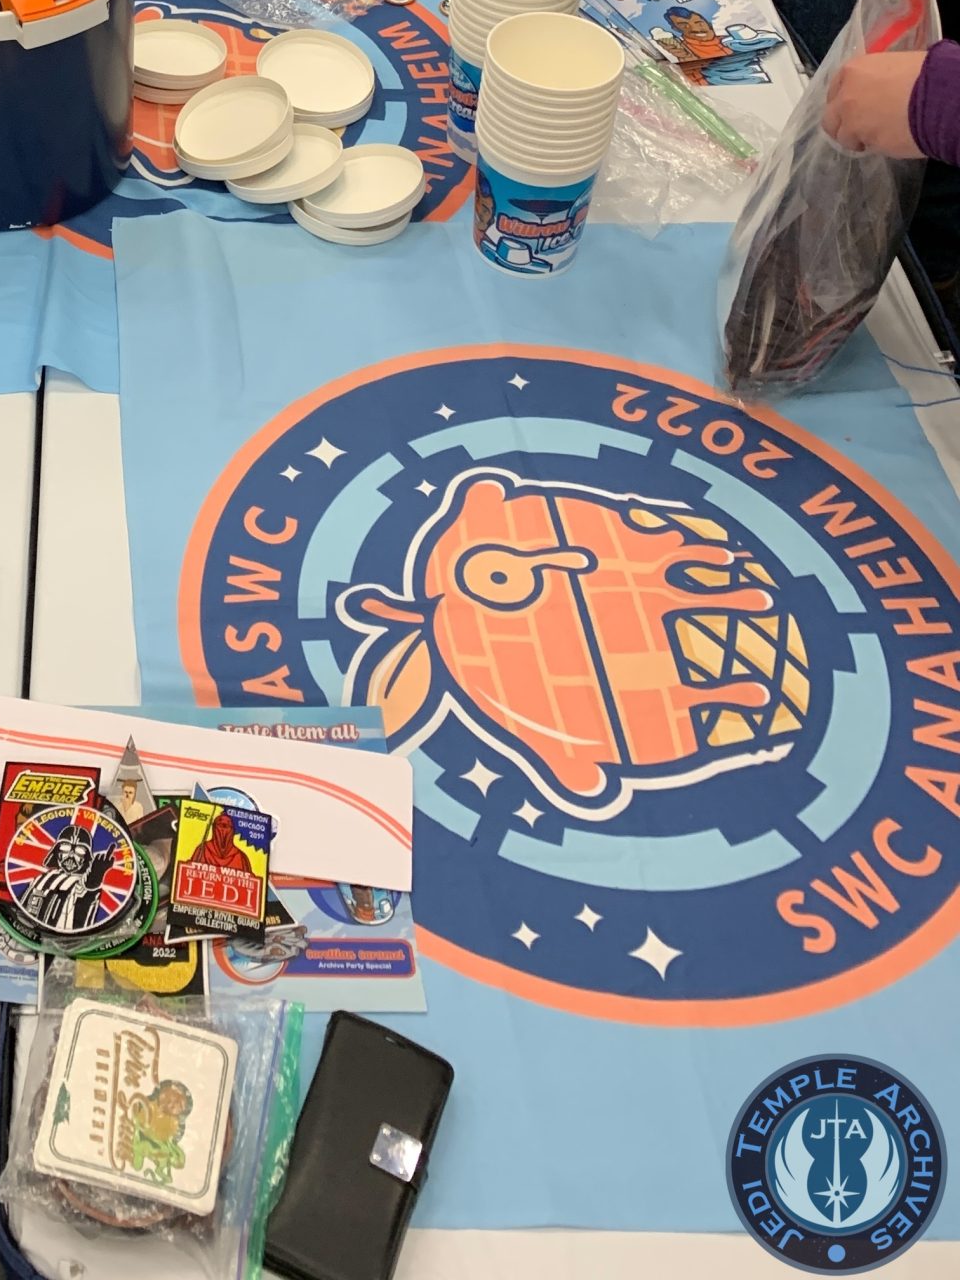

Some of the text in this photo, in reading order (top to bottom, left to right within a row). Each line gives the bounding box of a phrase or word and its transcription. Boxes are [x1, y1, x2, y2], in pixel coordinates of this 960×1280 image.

[542, 230, 568, 252] Ice
[611, 383, 796, 480] 2022
[225, 505, 306, 704] ASWC
[775, 484, 960, 955] SWC ANAHEIM
[276, 723, 327, 740] them
[330, 724, 359, 741] all
[14, 774, 85, 797] EMPIRE
[8, 790, 80, 805] STRIKES BACK
[226, 808, 269, 824] CELEBRATION
[238, 820, 266, 832] CHICAGO
[249, 831, 265, 840] 2019
[36, 808, 134, 876] LEGION VADER'S FINGER
[186, 870, 255, 889] RETURN OF THE
[190, 861, 252, 880] STAR WARS
[183, 878, 253, 908] JEDI
[172, 904, 261, 931] EMPEROR'S ROYAL GUARD
[195, 916, 238, 934] COLLECTORS
[152, 946, 177, 959] 2022
[318, 961, 393, 970] Archive Party Special
